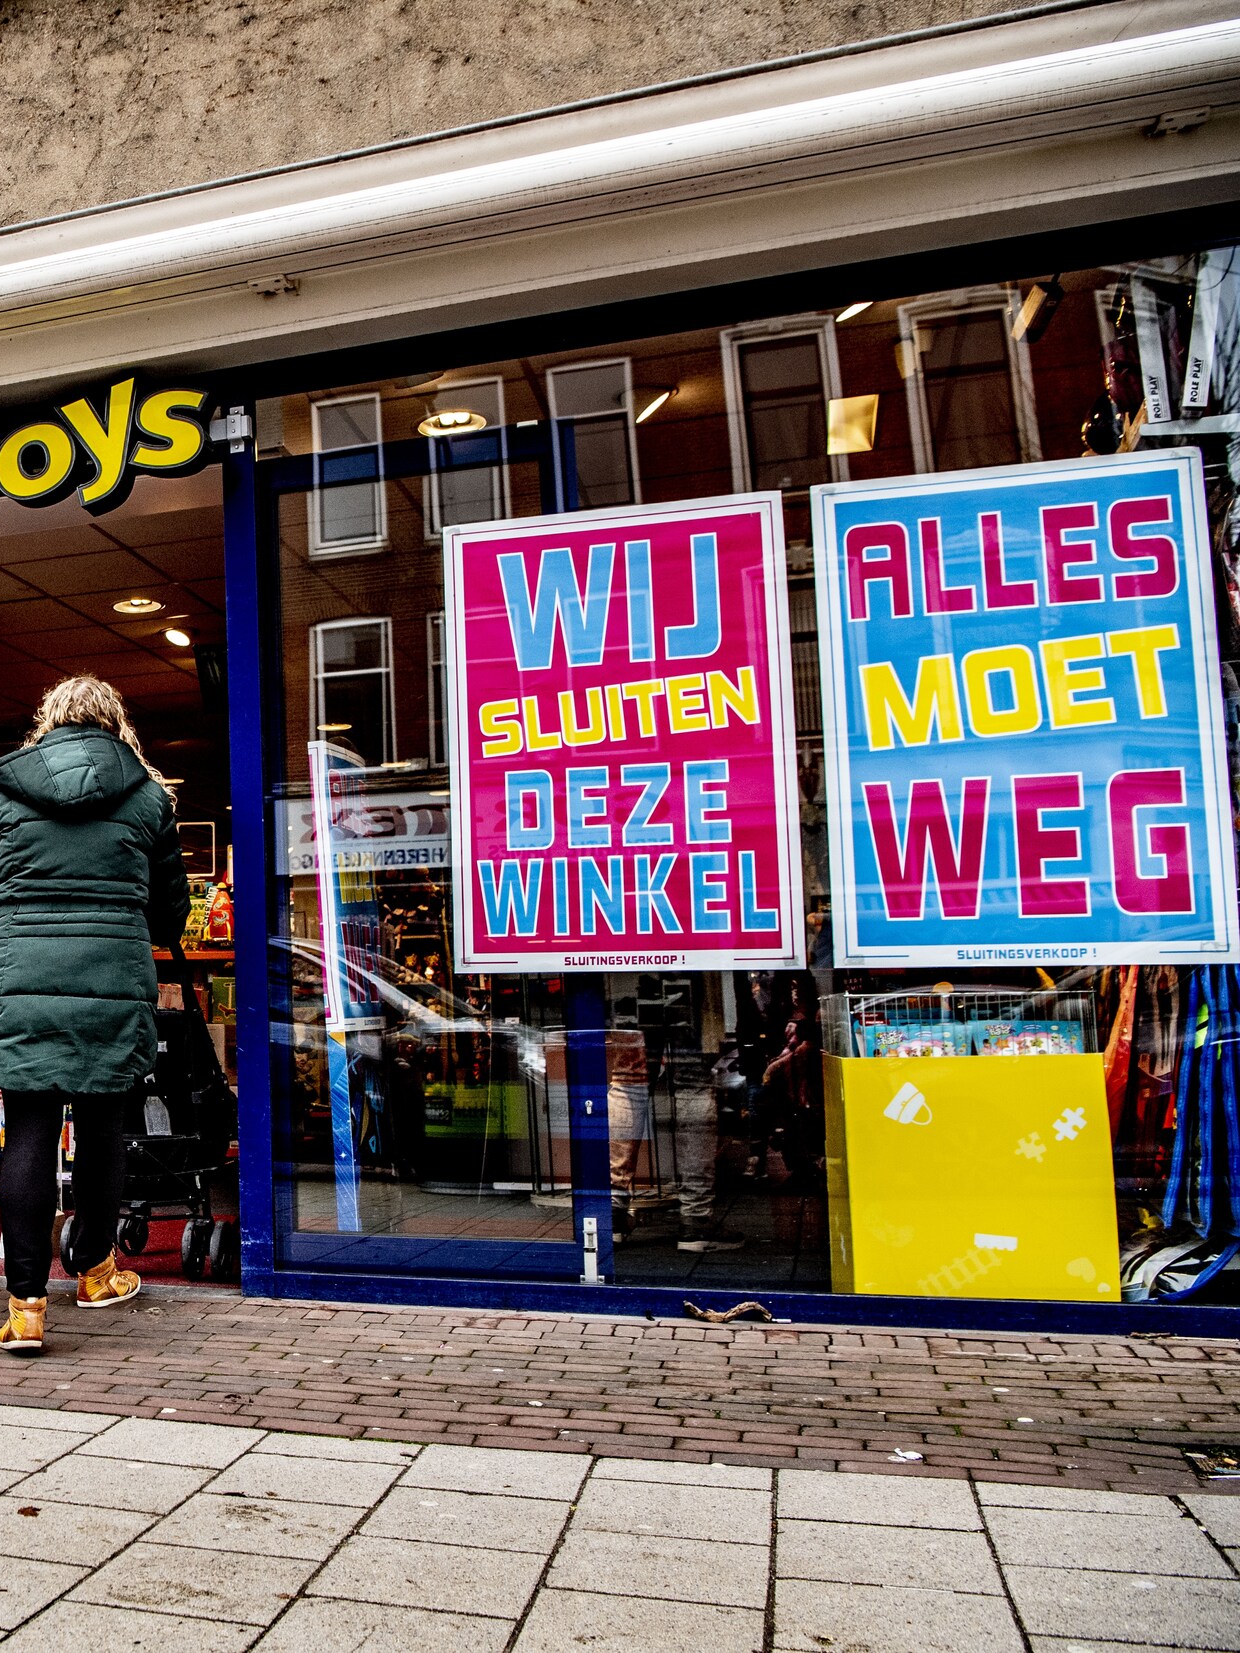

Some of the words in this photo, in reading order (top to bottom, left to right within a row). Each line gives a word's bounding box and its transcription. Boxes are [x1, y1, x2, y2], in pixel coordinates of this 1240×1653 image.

[1149, 376, 1160, 396] PLAY
[1190, 381, 1199, 403] ROLE
[1193, 357, 1203, 379] PLAY
[496, 532, 723, 671] WIJ
[843, 495, 1179, 623] ALLES
[478, 665, 761, 759] SLUITEN
[858, 623, 1181, 752] MOET
[504, 759, 732, 852] DEZE
[862, 767, 1196, 922] WEG
[477, 850, 780, 938] WINKEL
[564, 954, 678, 967] SLUITINGSVERKOOP
[681, 954, 686, 967] !
[957, 948, 1088, 961] SLUITINGSVERKOOP
[1092, 948, 1097, 961] !
